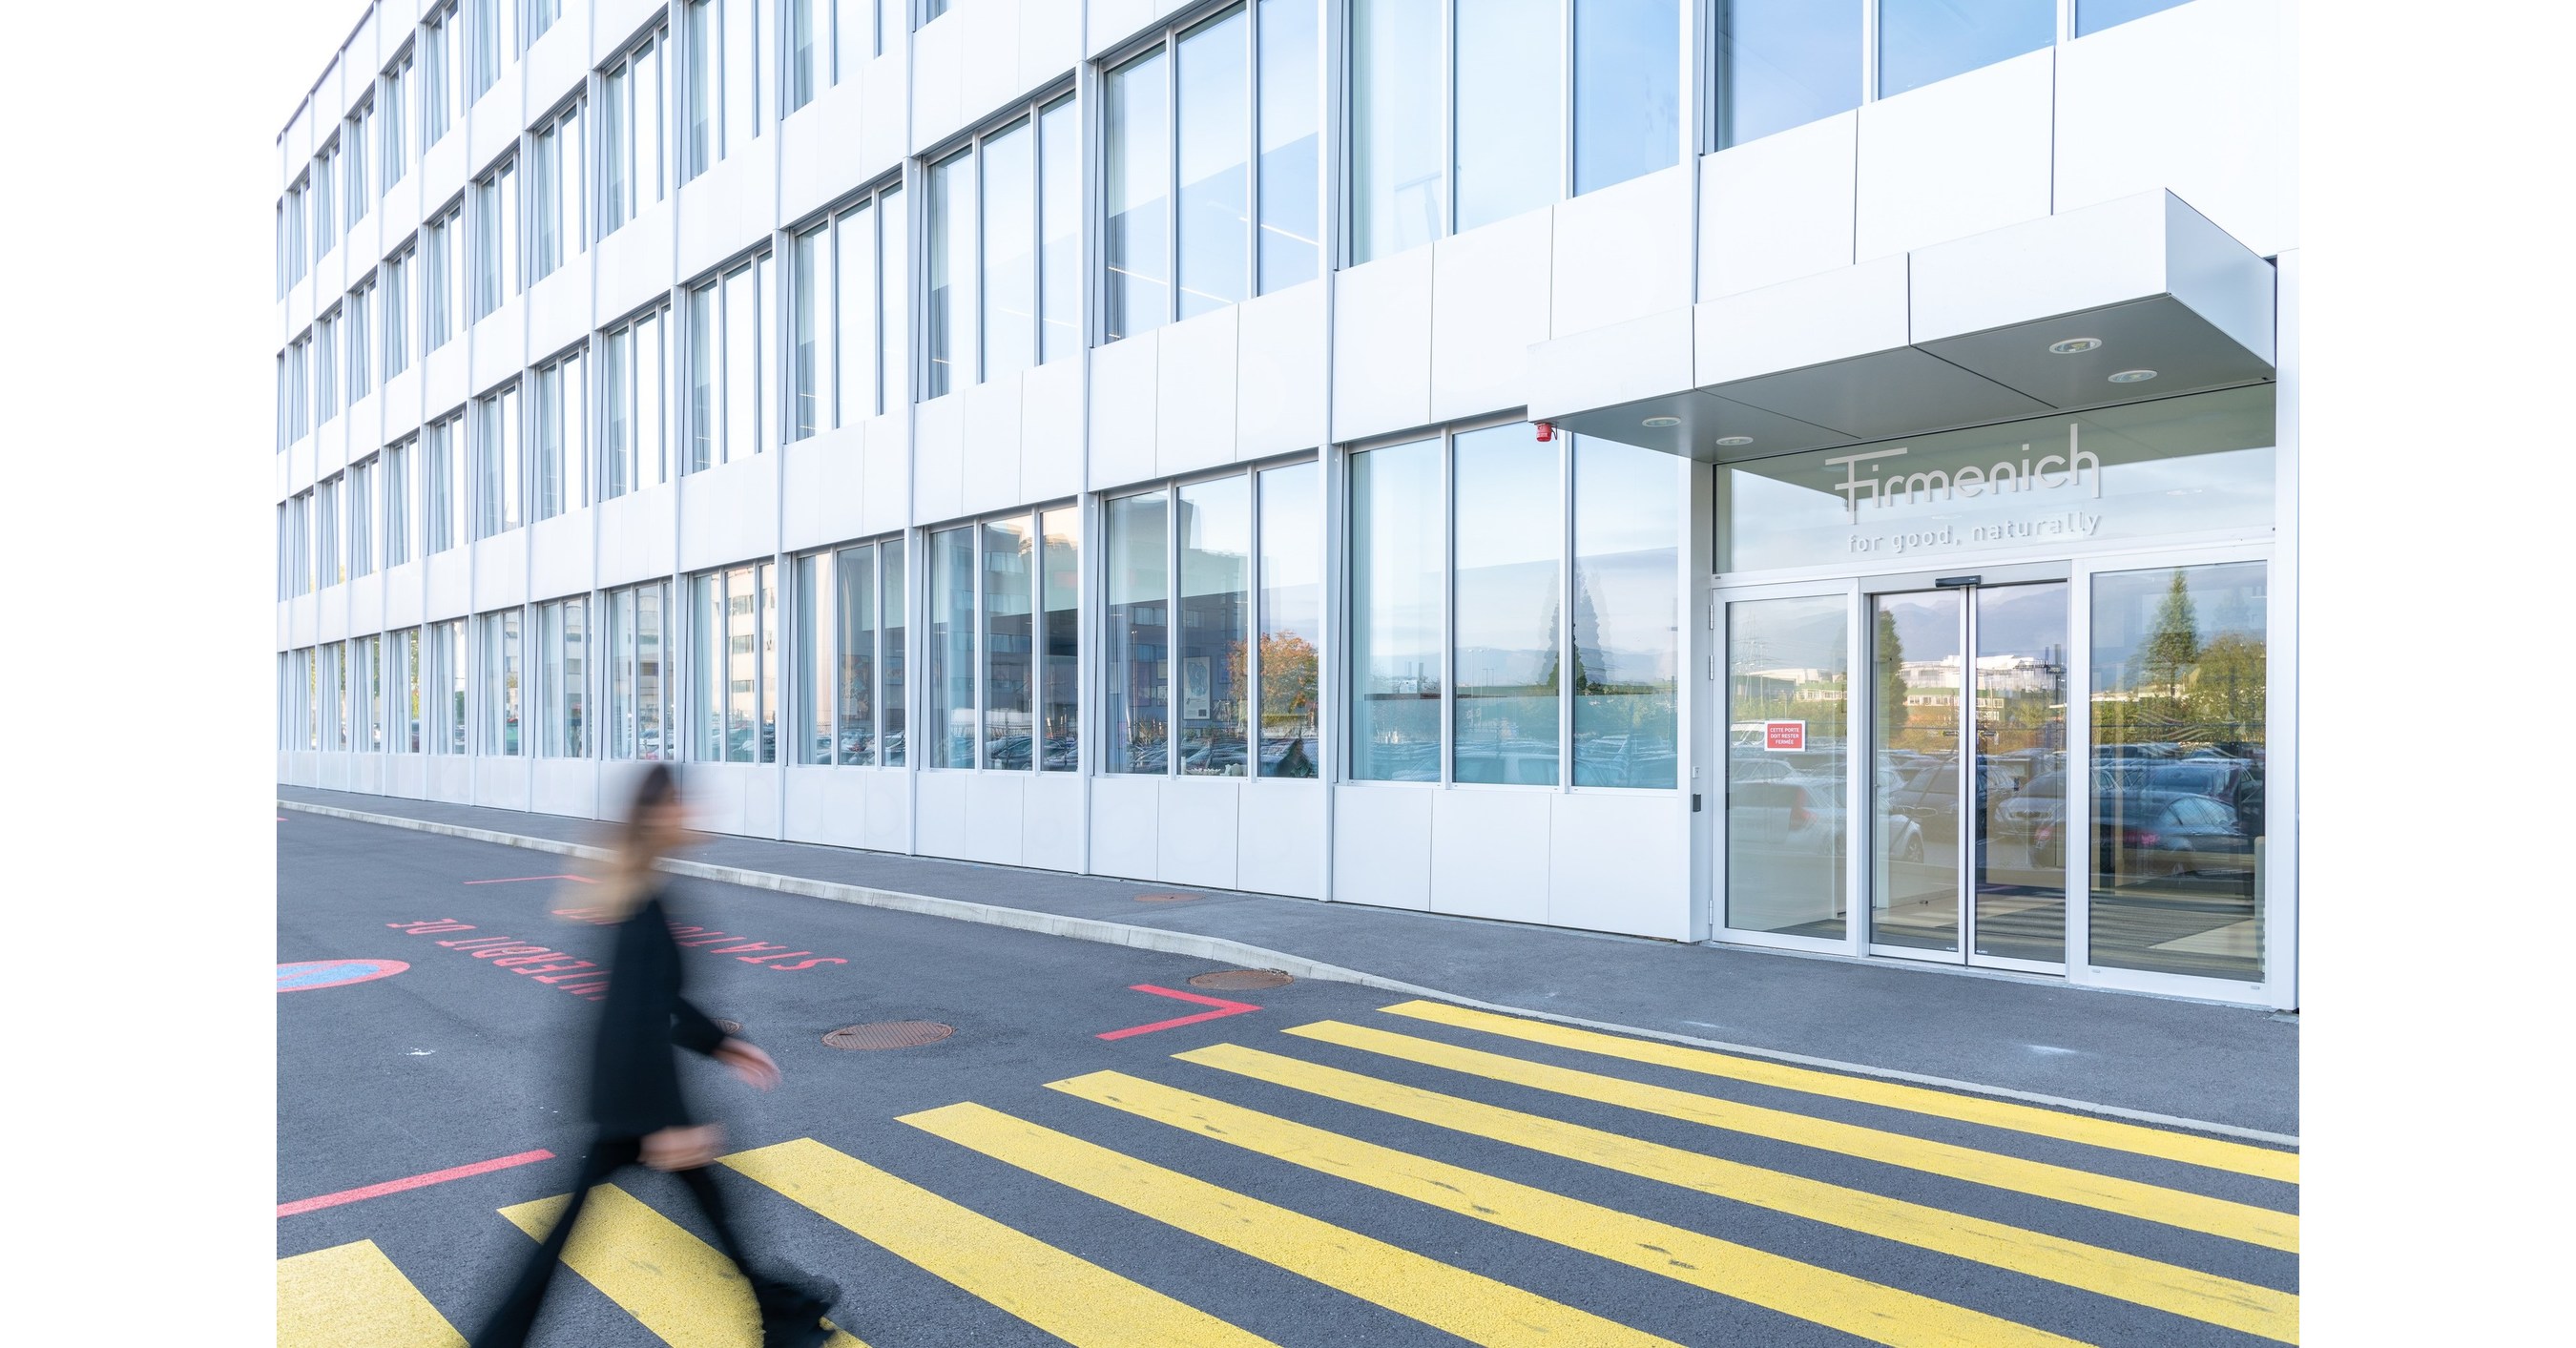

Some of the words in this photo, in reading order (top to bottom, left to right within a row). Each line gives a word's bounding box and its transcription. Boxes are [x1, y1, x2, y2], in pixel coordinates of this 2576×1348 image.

[1825, 424, 2100, 525] Firmenich
[1849, 533, 1883, 552] for
[1891, 525, 1962, 554] good,
[1972, 511, 2102, 542] naturally
[385, 918, 477, 935] DE
